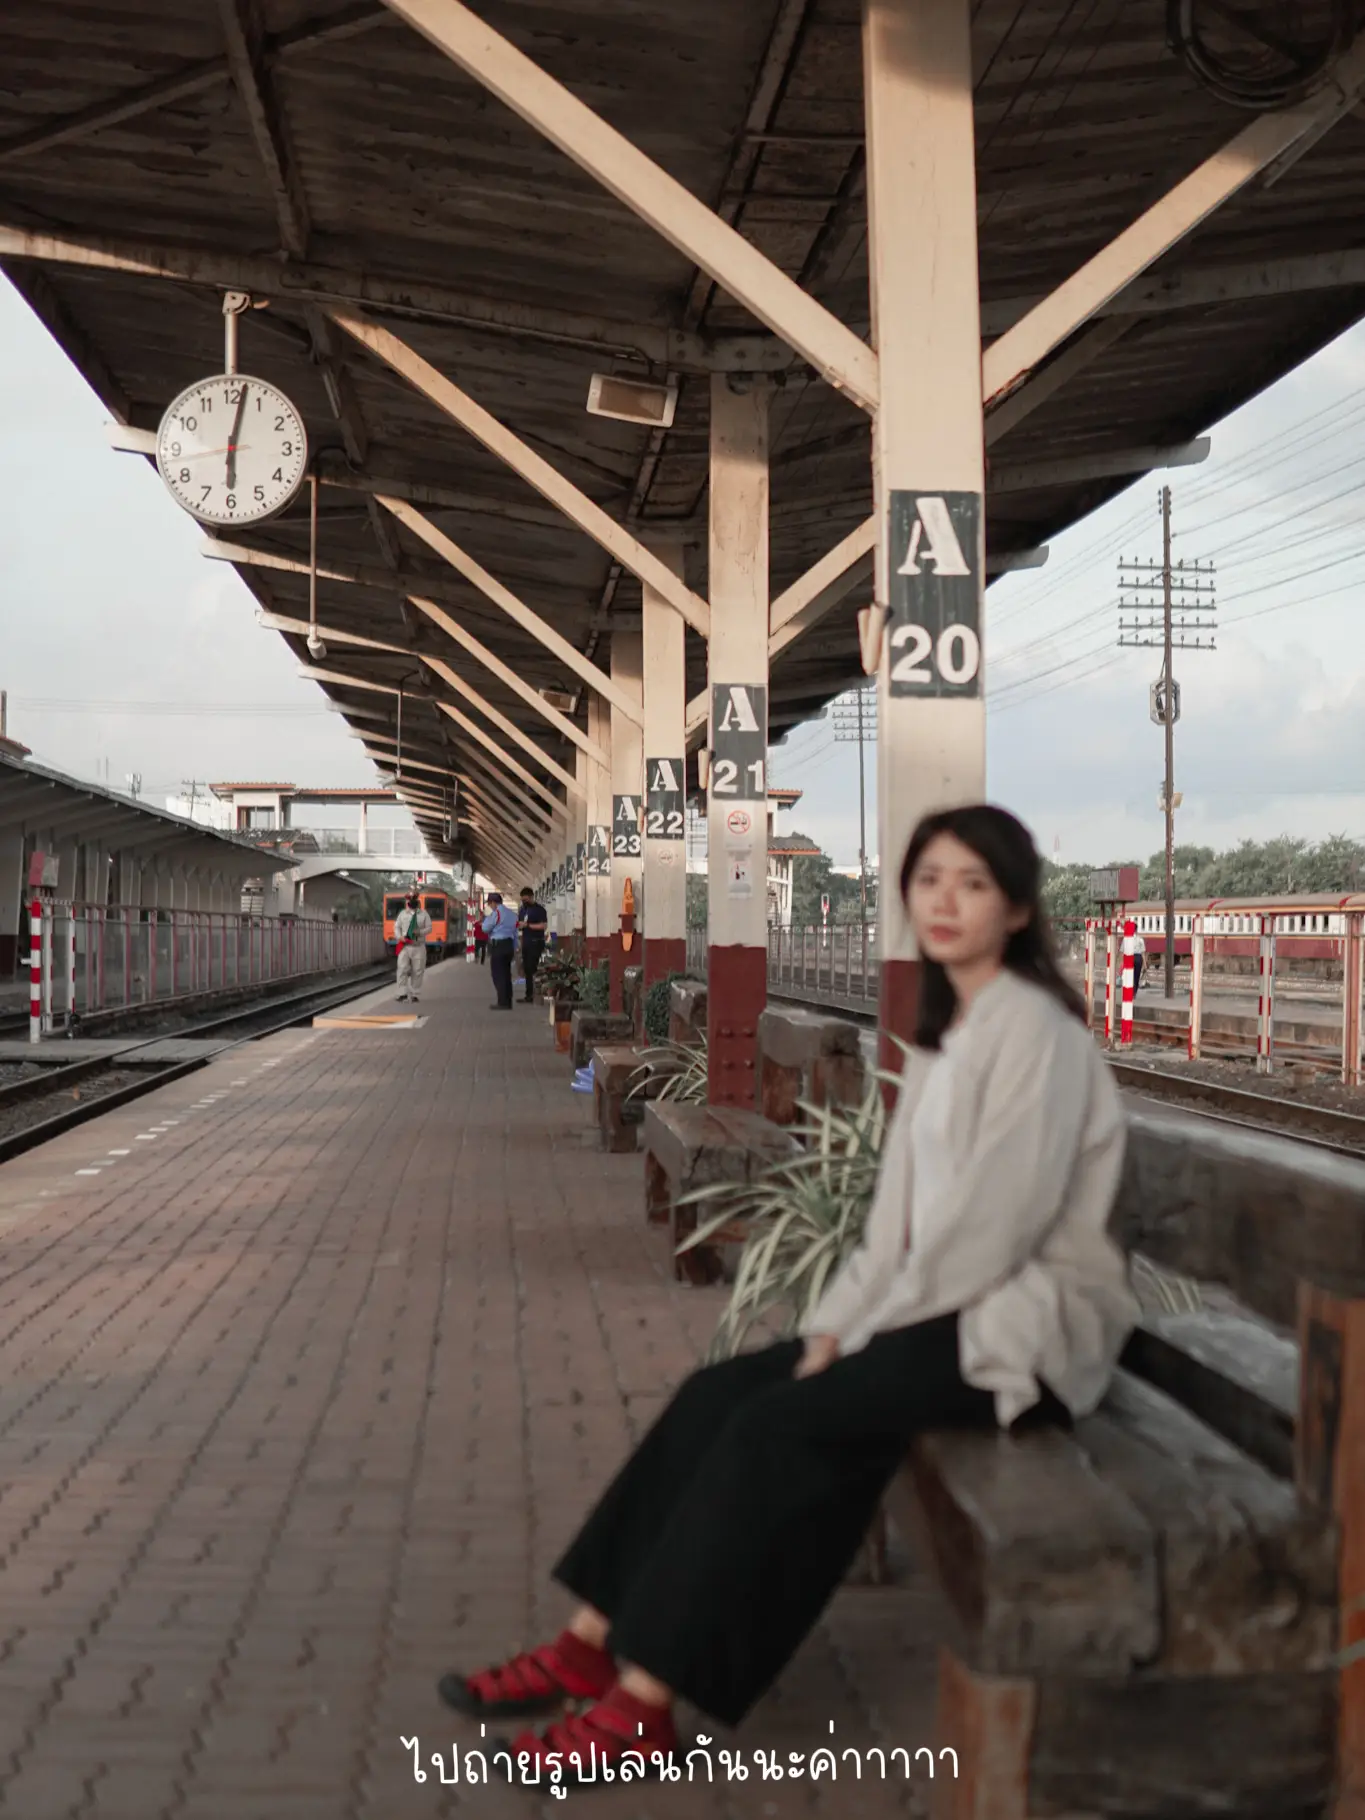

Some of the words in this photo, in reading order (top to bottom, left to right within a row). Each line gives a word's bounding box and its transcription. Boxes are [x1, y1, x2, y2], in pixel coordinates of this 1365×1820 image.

[224, 389, 240, 404] 12
[200, 397, 212, 412] 11
[256, 397, 261, 412] 1
[180, 416, 197, 431] 10
[274, 416, 285, 431] 2
[171, 442, 181, 457] 9
[281, 441, 292, 456] 3
[180, 468, 190, 483] 8
[272, 467, 282, 482] 4
[201, 486, 212, 501] 7
[254, 485, 265, 500] 5
[226, 494, 236, 509] 6
[897, 497, 971, 575] A
[891, 624, 979, 684] 20
[718, 686, 760, 731] A
[650, 760, 680, 791] A
[713, 760, 764, 793] 21
[616, 796, 638, 821] A
[648, 811, 683, 834] 22
[591, 827, 606, 847] A
[614, 835, 641, 854] 23
[588, 858, 611, 873] 24
